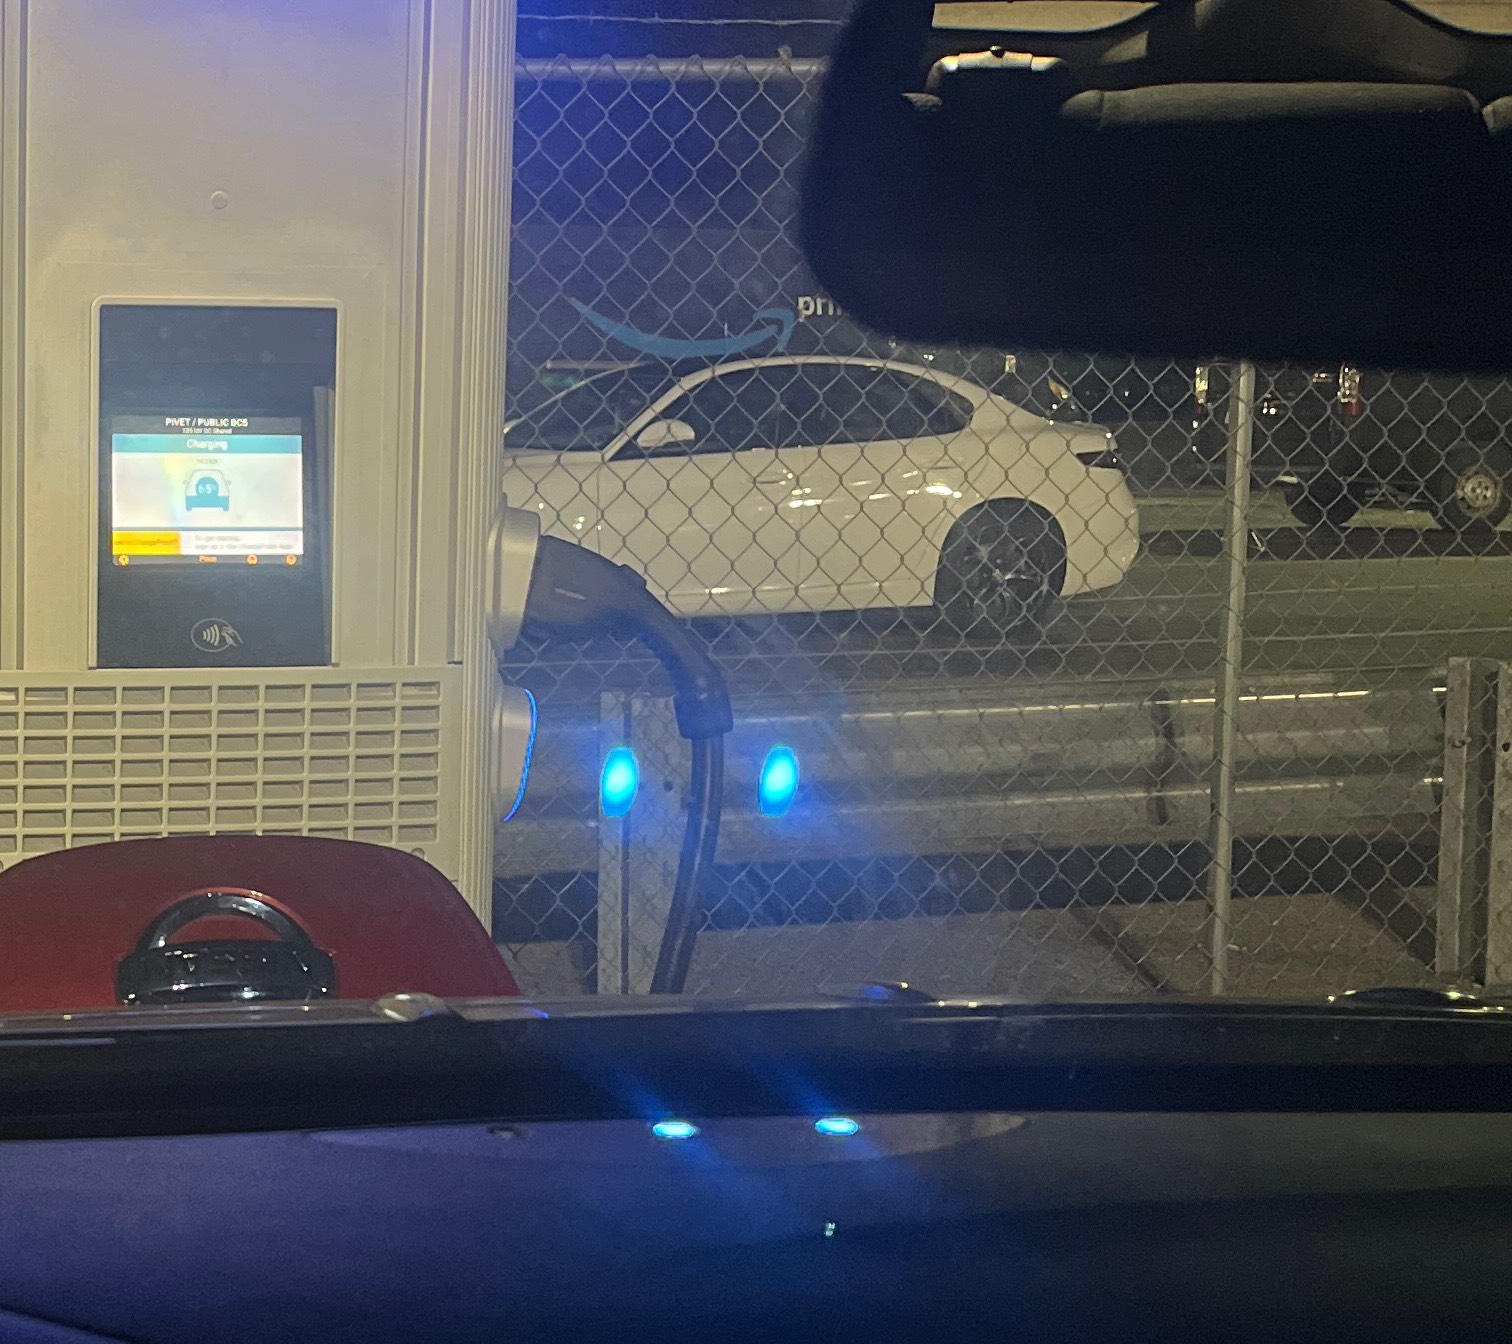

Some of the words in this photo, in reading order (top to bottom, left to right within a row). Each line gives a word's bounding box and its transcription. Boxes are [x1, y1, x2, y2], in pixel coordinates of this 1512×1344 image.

[165, 417, 191, 427] PIVET
[197, 418, 230, 427] PUBLIC
[187, 438, 228, 451] Charging
